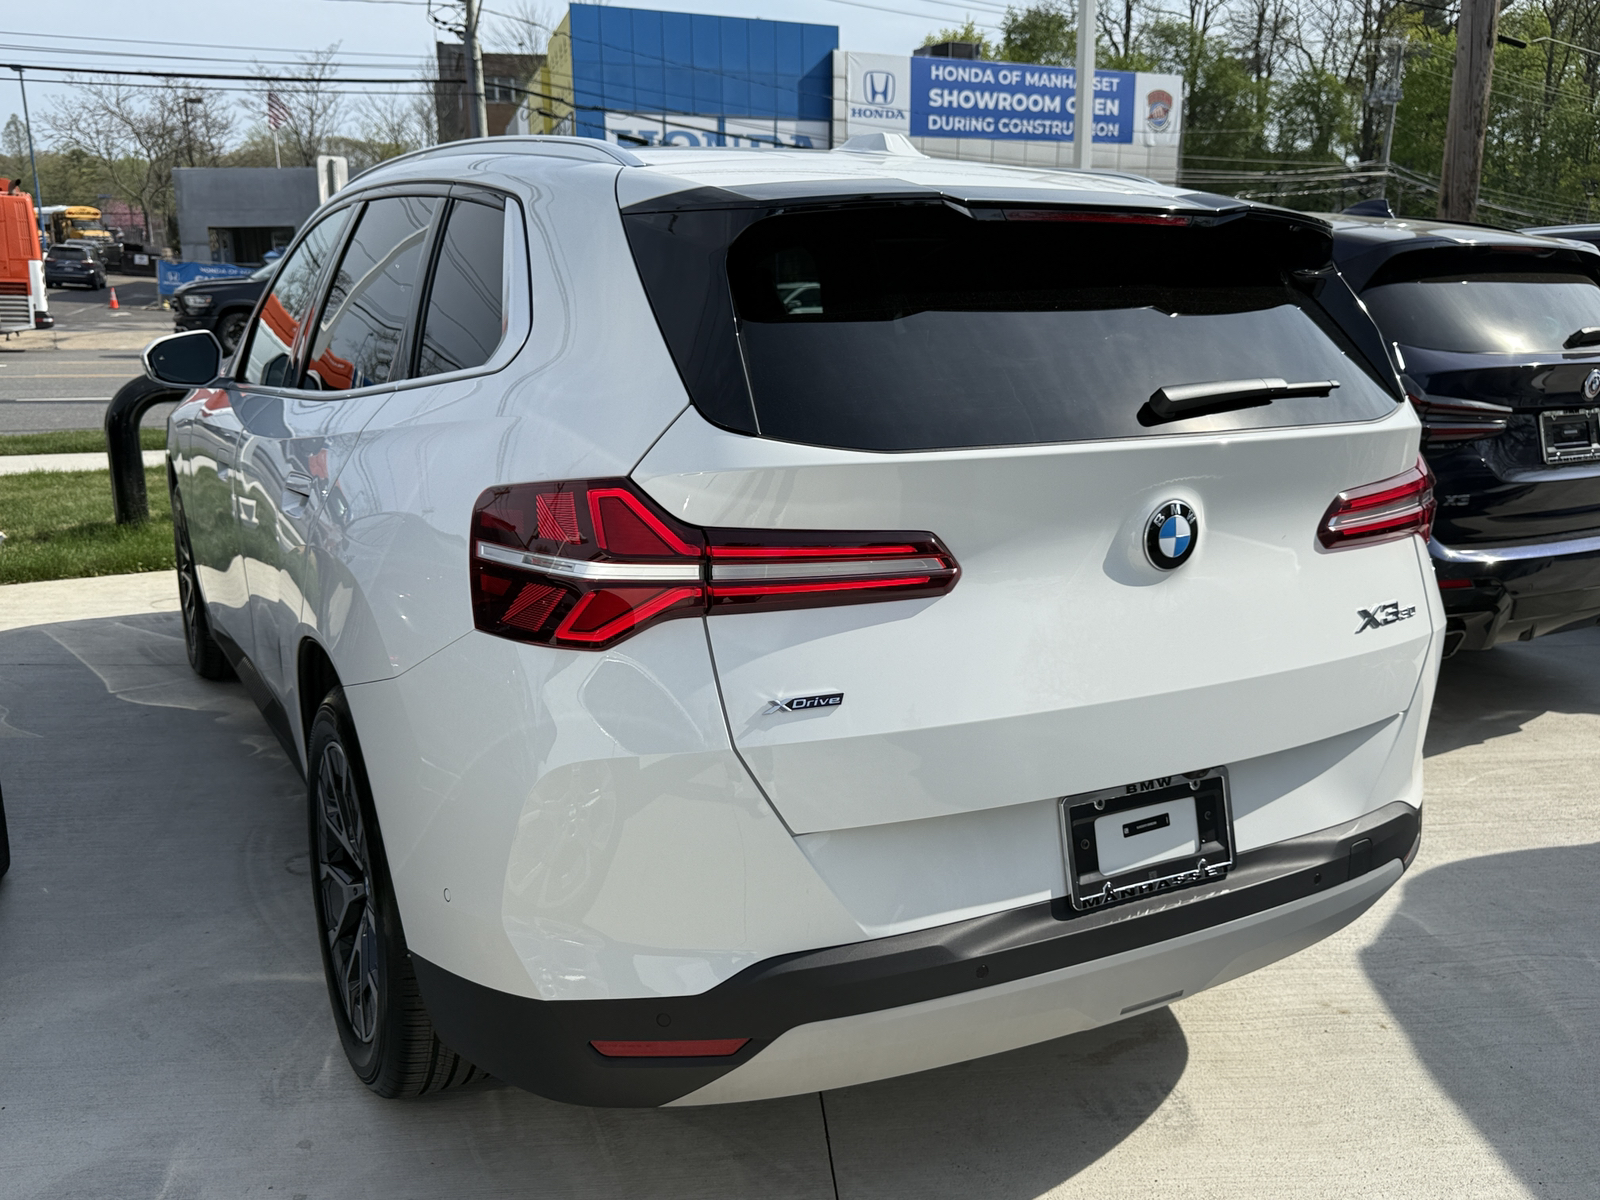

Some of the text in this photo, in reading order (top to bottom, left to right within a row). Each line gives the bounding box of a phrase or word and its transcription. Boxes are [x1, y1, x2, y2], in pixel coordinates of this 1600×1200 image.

[930, 64, 1120, 92] HONDA OF MANHSET
[850, 107, 907, 120] HONDA
[928, 88, 1060, 113] SHOWROOM
[1065, 95, 1120, 116] OEN
[928, 114, 1120, 137] DURING CONSTRUION
[1153, 503, 1197, 527] BMW
[1125, 776, 1173, 795] BMW
